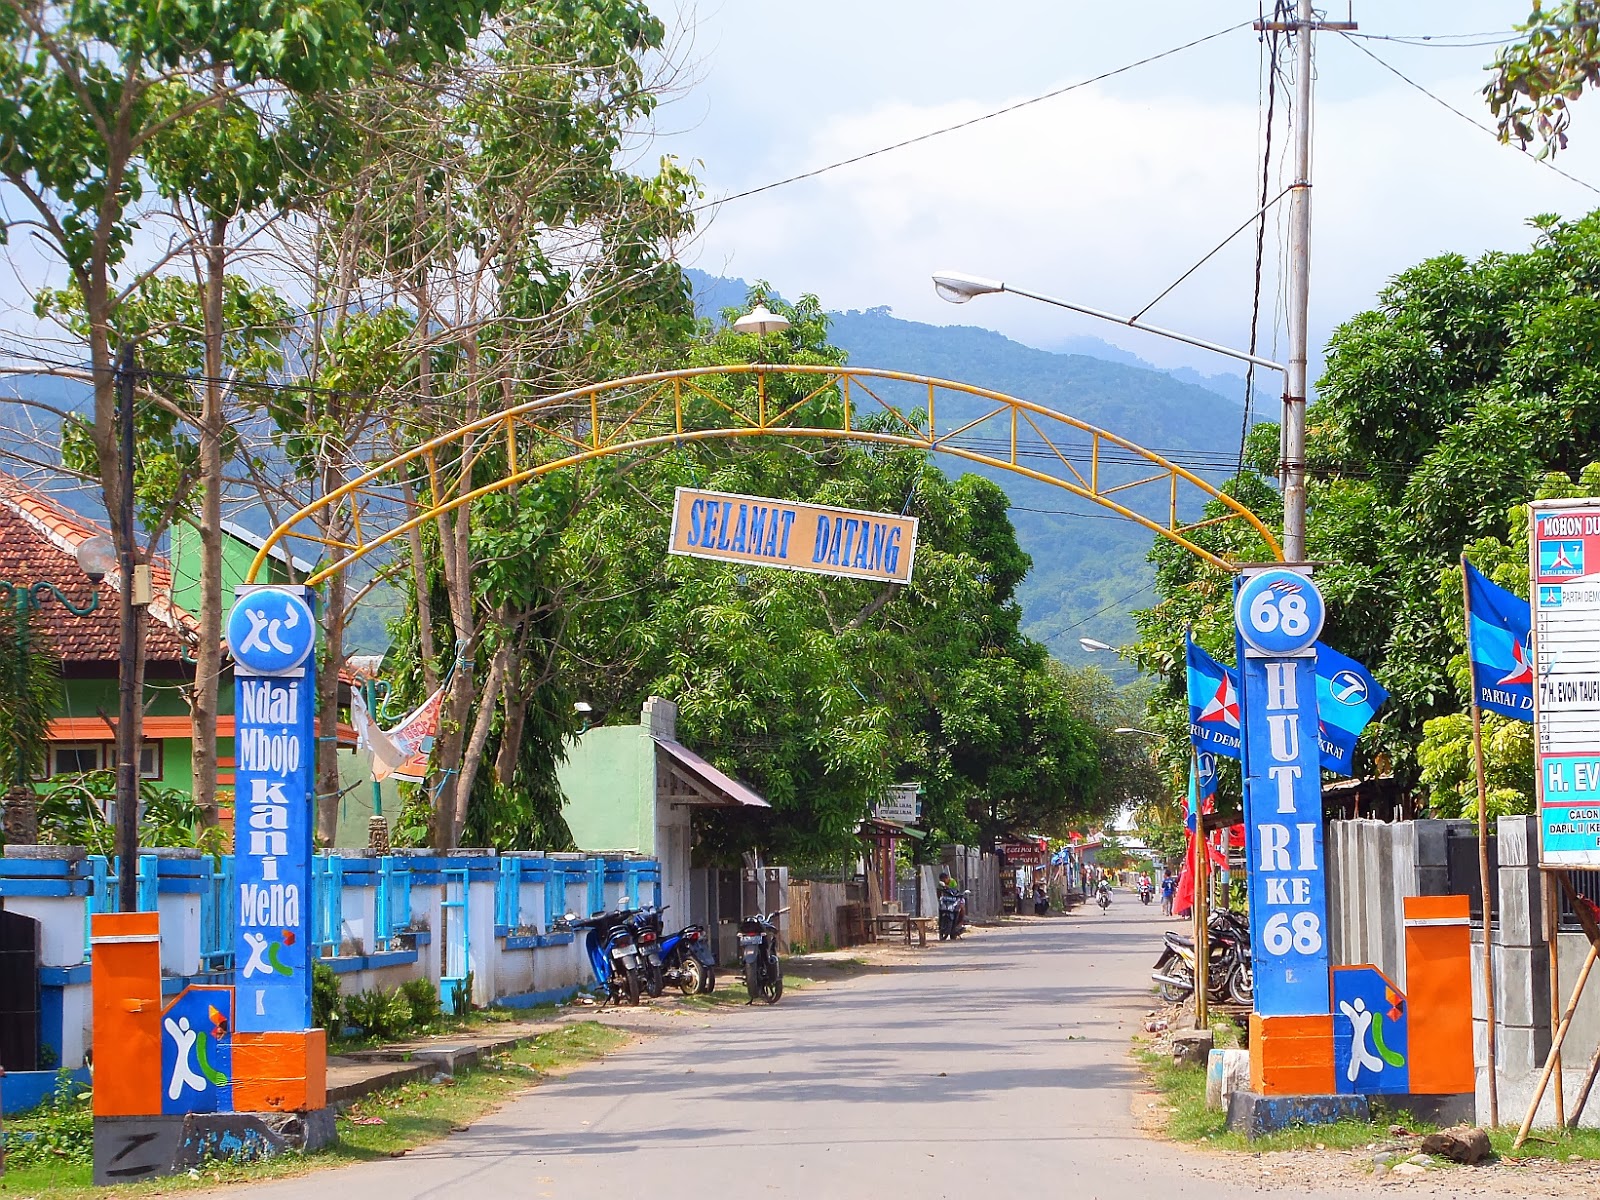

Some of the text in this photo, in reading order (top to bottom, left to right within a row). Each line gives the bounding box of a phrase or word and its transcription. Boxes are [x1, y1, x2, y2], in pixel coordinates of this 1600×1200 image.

[687, 498, 902, 574] SELAMAT DATANG
[1543, 517, 1583, 536] MOHON
[1573, 546, 1580, 558] 7
[1562, 591, 1583, 603] PARTAI
[1250, 590, 1310, 637] 68
[1336, 673, 1366, 701] 7
[1481, 687, 1533, 710] PARTAI D
[1540, 684, 1547, 705] 7
[1549, 682, 1556, 703] H.
[1558, 682, 1577, 702] EVON
[241, 680, 298, 724] Ndai
[1190, 724, 1210, 740] RTAI
[1264, 662, 1302, 814] HUT
[240, 728, 300, 777] Mbojo
[1548, 763, 1569, 792] H.
[1549, 824, 1575, 834] DAPIL
[1569, 810, 1599, 820] CALON
[249, 779, 290, 881] kani
[1258, 824, 1318, 871] RI
[240, 883, 300, 927] Mena
[1266, 878, 1311, 905] KE
[1263, 911, 1322, 955] 68
